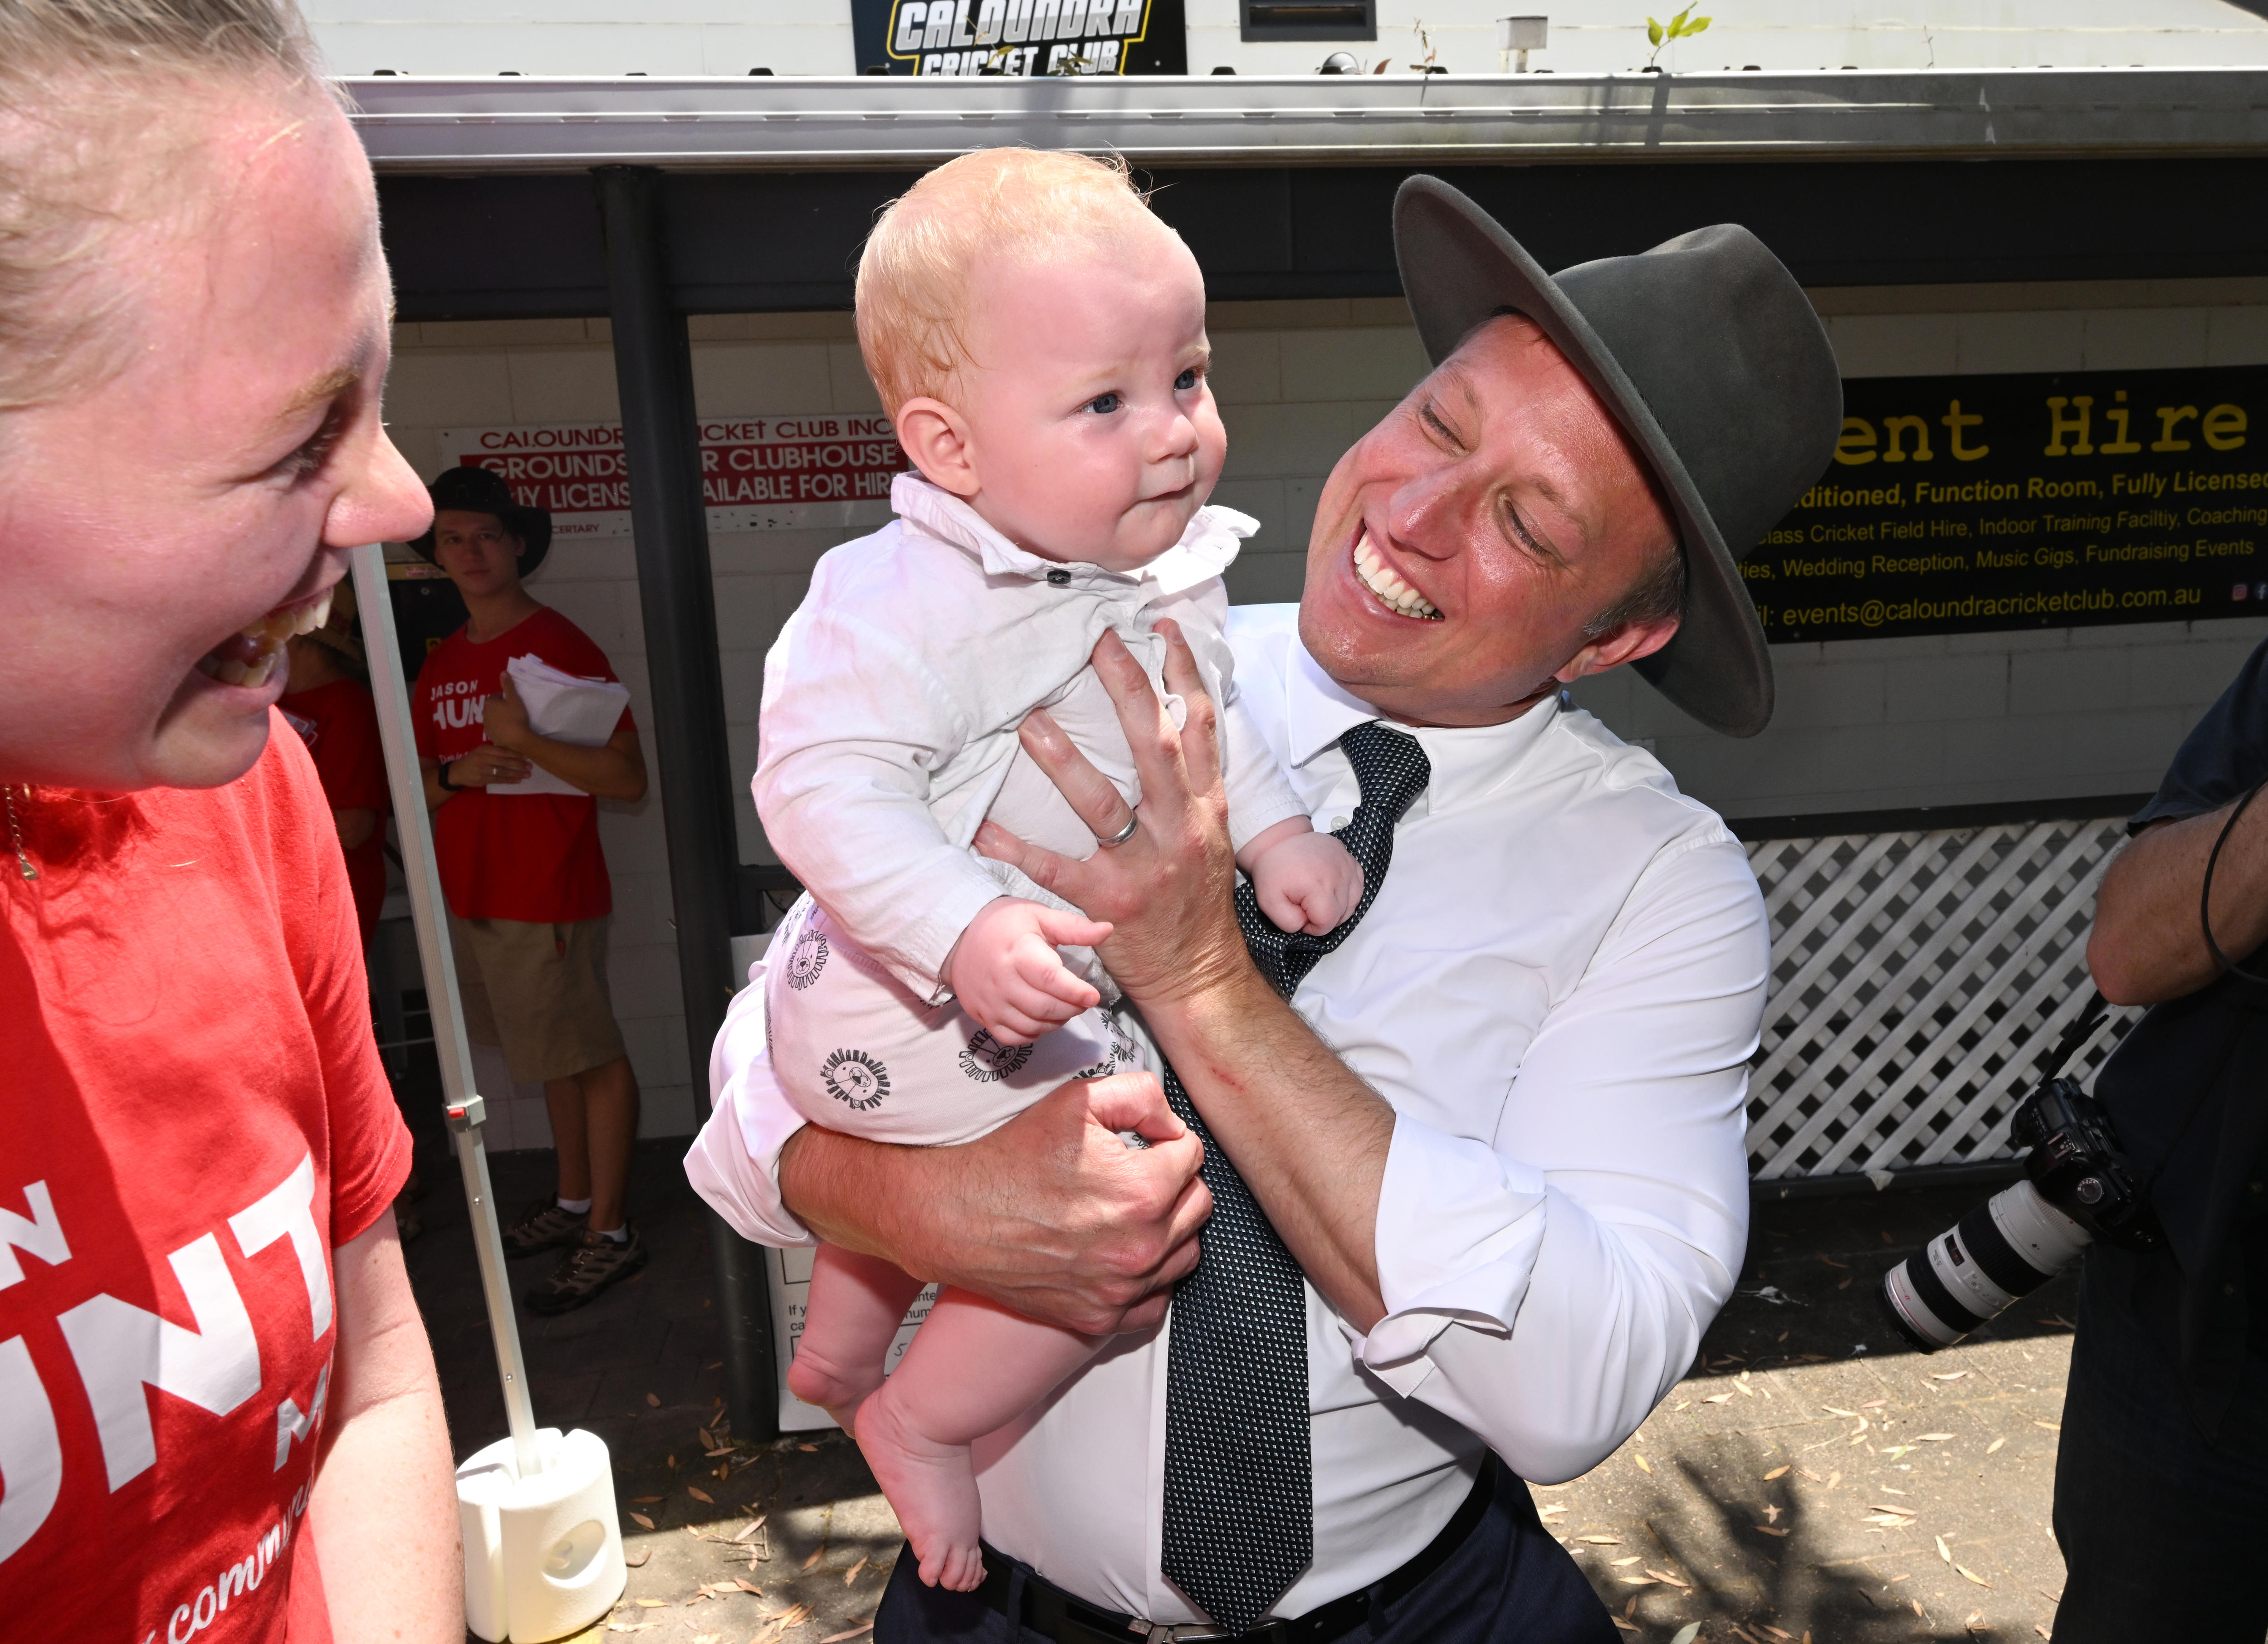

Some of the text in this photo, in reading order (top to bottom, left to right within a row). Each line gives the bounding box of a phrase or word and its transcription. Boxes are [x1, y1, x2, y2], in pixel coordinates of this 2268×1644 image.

[895, 0, 1143, 50] CALOUNDRA
[922, 40, 1120, 76] CRICKET CLUB
[776, 420, 839, 439] CLUB
[1833, 390, 2248, 465] ent Hire
[479, 454, 628, 478] GROUNDS
[729, 444, 897, 472] CLUBHOUSE
[799, 473, 848, 499] FOR
[1794, 483, 1906, 509] ditioned,
[1916, 480, 2019, 504] Function
[2028, 478, 2106, 501] Room,
[2112, 473, 2169, 499] Fully
[1810, 524, 1875, 543] Cricket
[1881, 521, 1925, 539] Field
[1931, 519, 1972, 538] Hire,
[1980, 517, 2038, 535] Indoor
[2043, 514, 2112, 534] Training
[2188, 506, 2268, 526] Coaching
[1784, 558, 1866, 579] Wedding
[1872, 553, 1970, 576] Reception,
[1976, 550, 2029, 568] Music
[2034, 547, 2079, 569] Gigs,
[2086, 542, 2190, 563] Fundraising
[2196, 539, 2254, 557] Events
[1783, 588, 2202, 627] events@caloundracricketclub.com.au
[430, 679, 478, 701] JASON
[788, 1304, 797, 1316] If
[914, 1291, 936, 1302] nte
